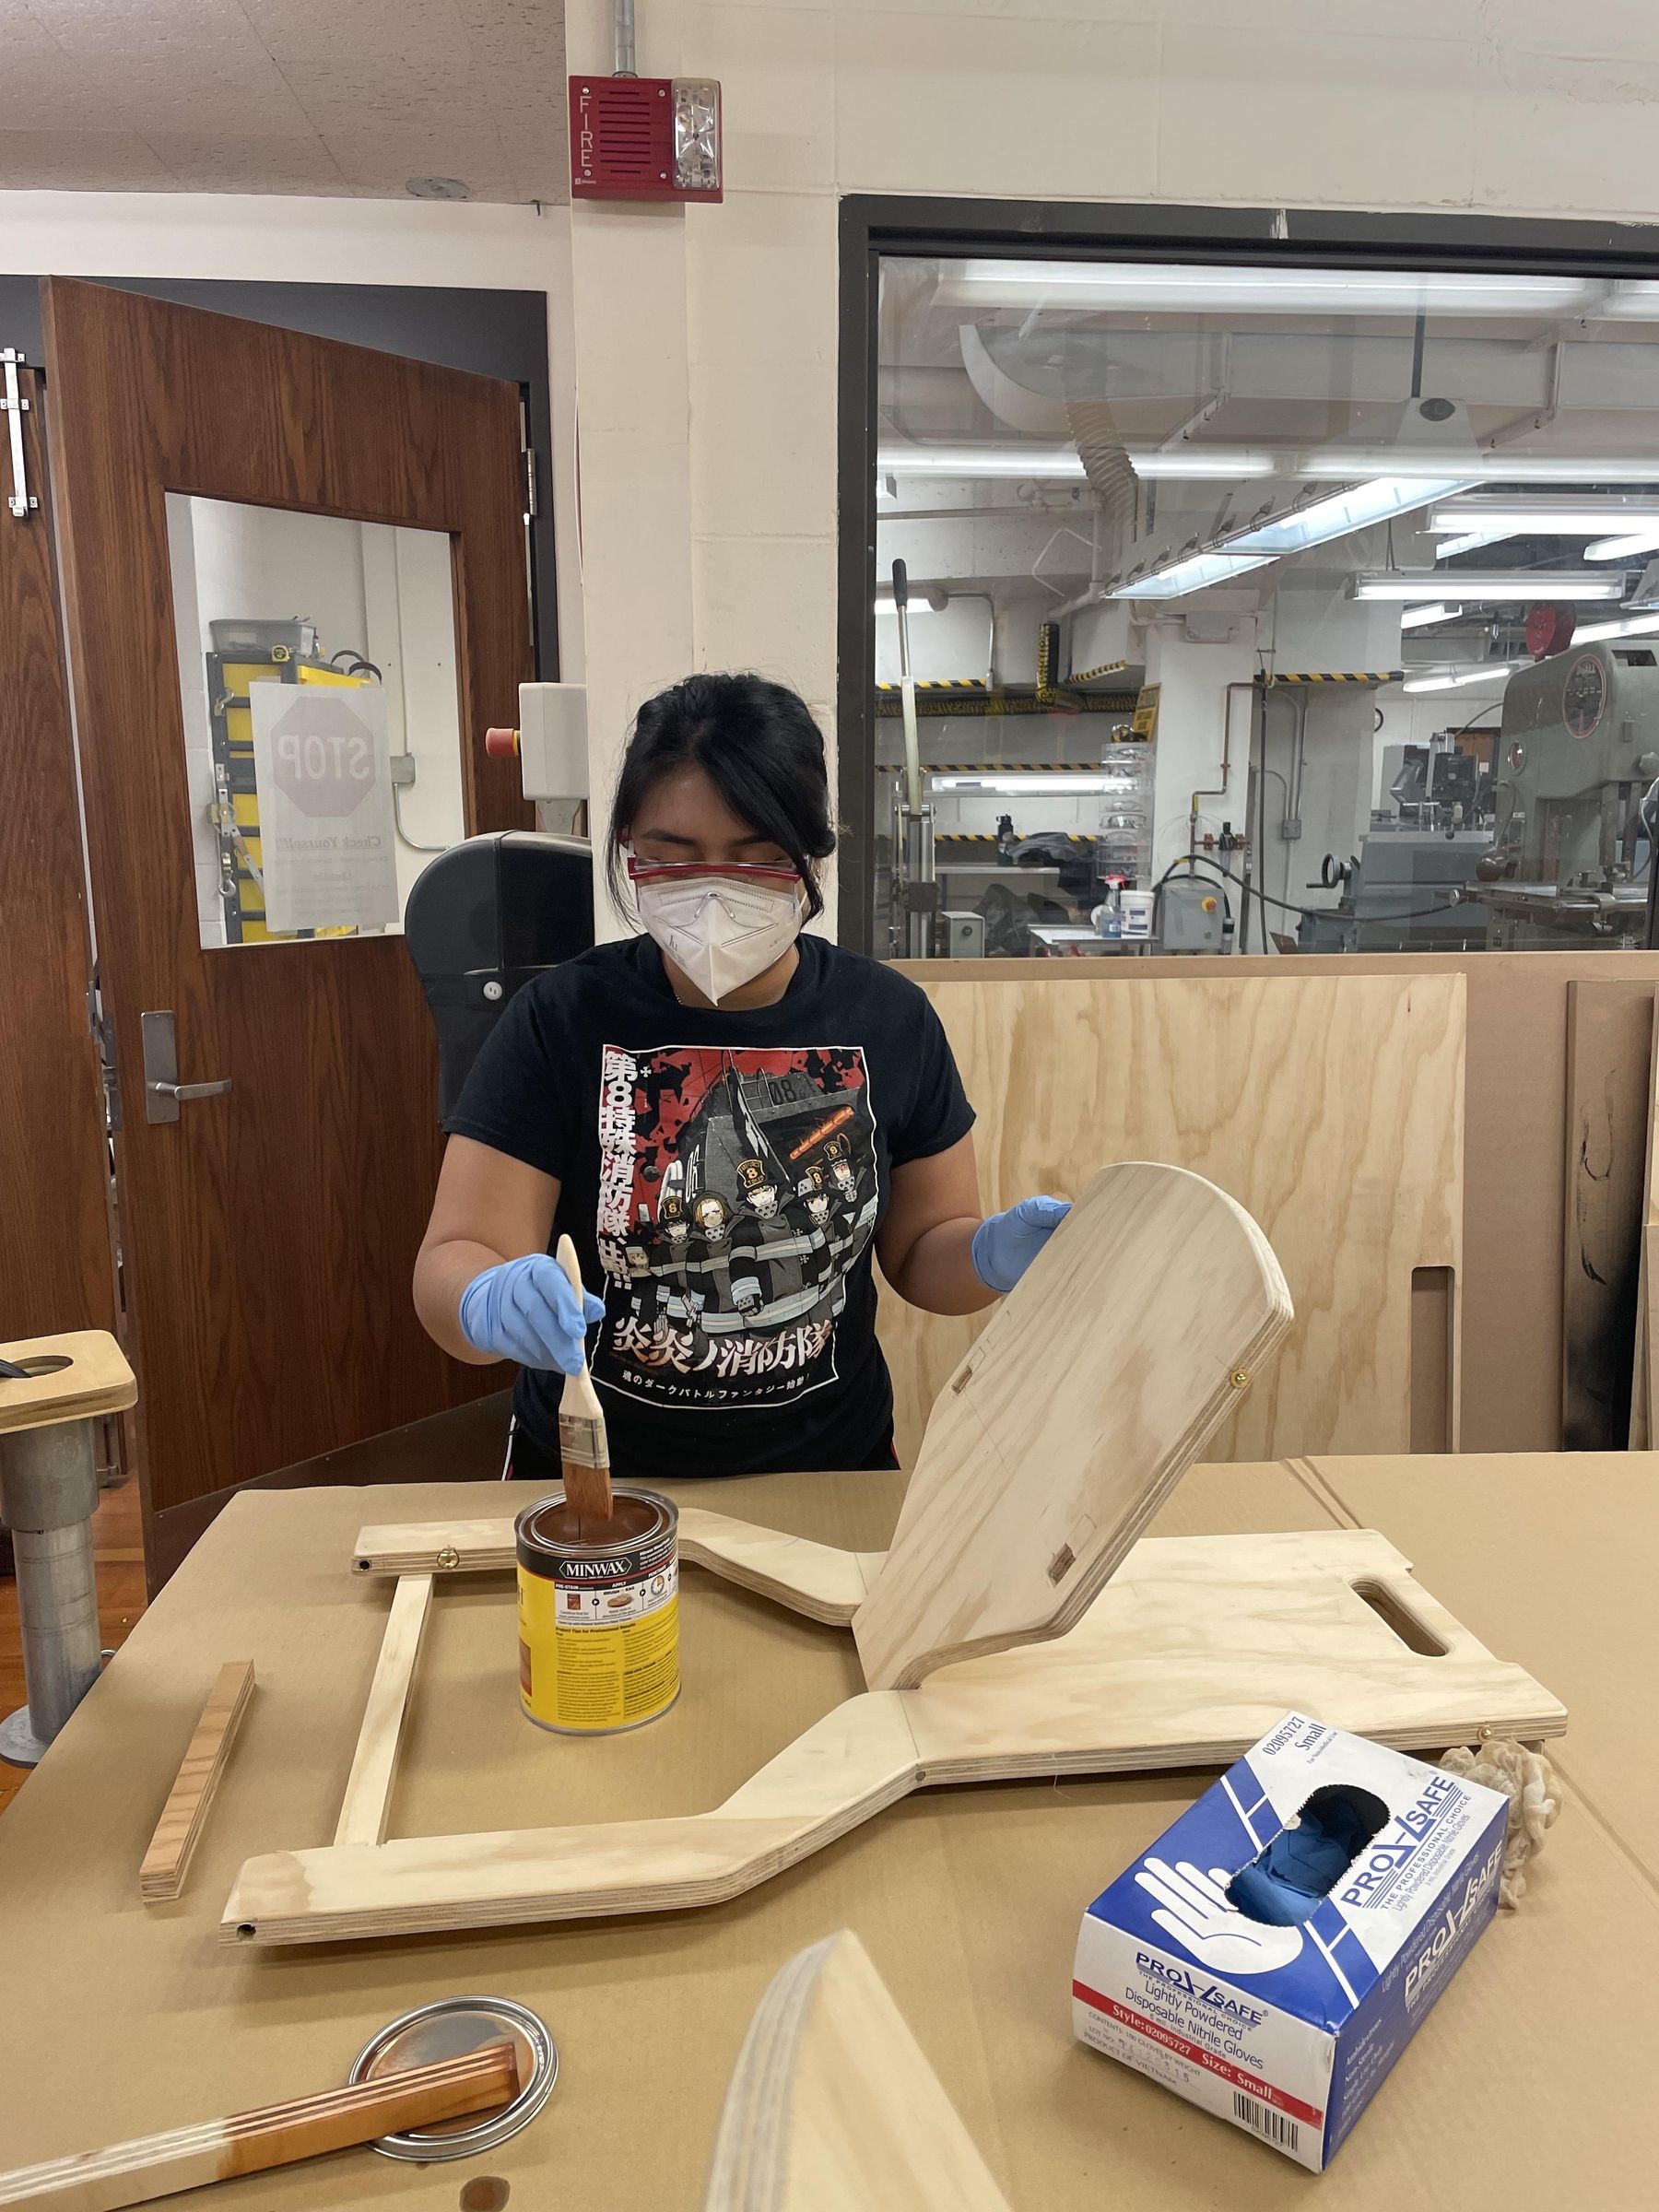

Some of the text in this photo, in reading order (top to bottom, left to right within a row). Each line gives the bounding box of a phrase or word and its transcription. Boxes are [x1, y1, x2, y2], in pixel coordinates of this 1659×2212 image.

[580, 95, 594, 168] FIRE
[747, 1167, 759, 1179] 8
[566, 1560, 625, 1577] MINWAX
[1262, 1716, 1305, 1756] 02095727
[1294, 1723, 1327, 1751] Small
[1381, 1892, 1399, 1910] THE
[1395, 1827, 1449, 1890] PROFESSIONAL
[1445, 1794, 1472, 1825] CHOICE
[1138, 1971, 1253, 2031] THE PROFESSIONAL CHOICE
[1145, 1980, 1242, 2041] Lightly Powdered
[1125, 1986, 1264, 2070] Disposable Nitrile Gloves
[1171, 2024, 1203, 2045] Industrial
[1205, 2042, 1227, 2059] Grade
[1135, 2058, 1177, 2086] VIETNAM
[1202, 2053, 1231, 2077] Size:
[1236, 2072, 1272, 2100] Small
